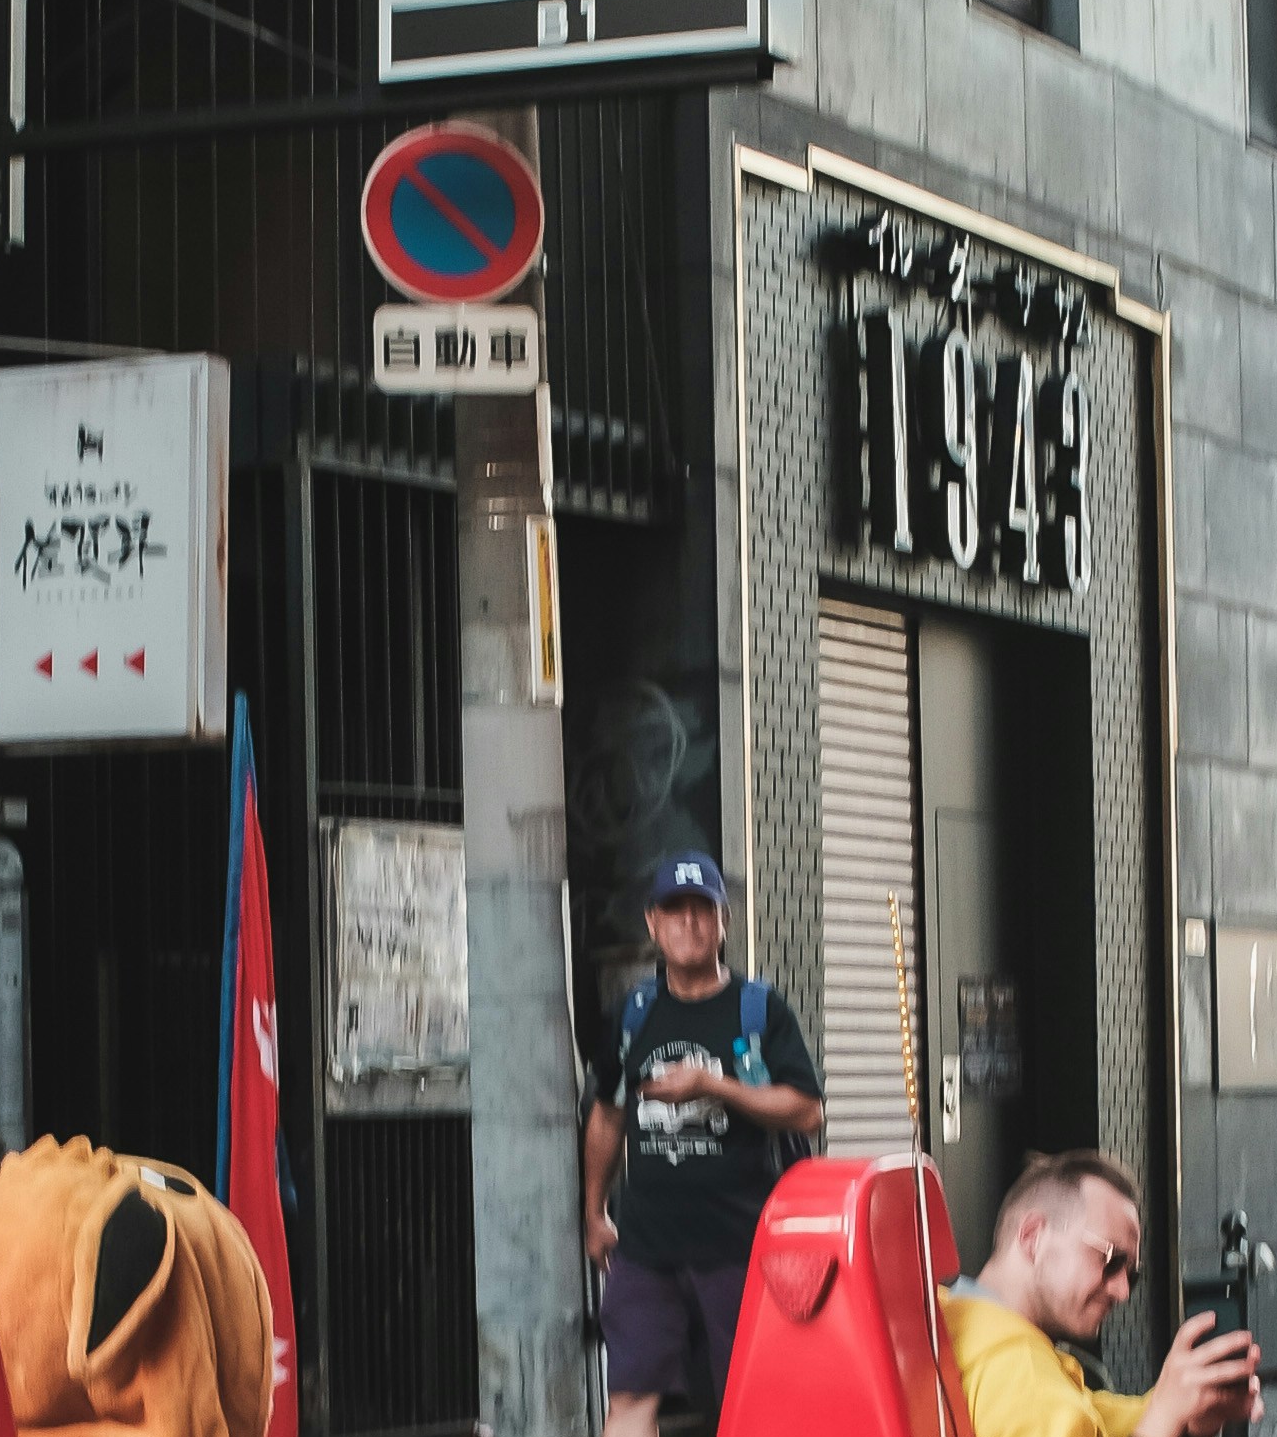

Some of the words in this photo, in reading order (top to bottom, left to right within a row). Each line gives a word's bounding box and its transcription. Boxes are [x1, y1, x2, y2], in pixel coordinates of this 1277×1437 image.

[383, 323, 530, 373] 自動車
[885, 307, 1092, 597] 1943
[675, 863, 704, 886] M
